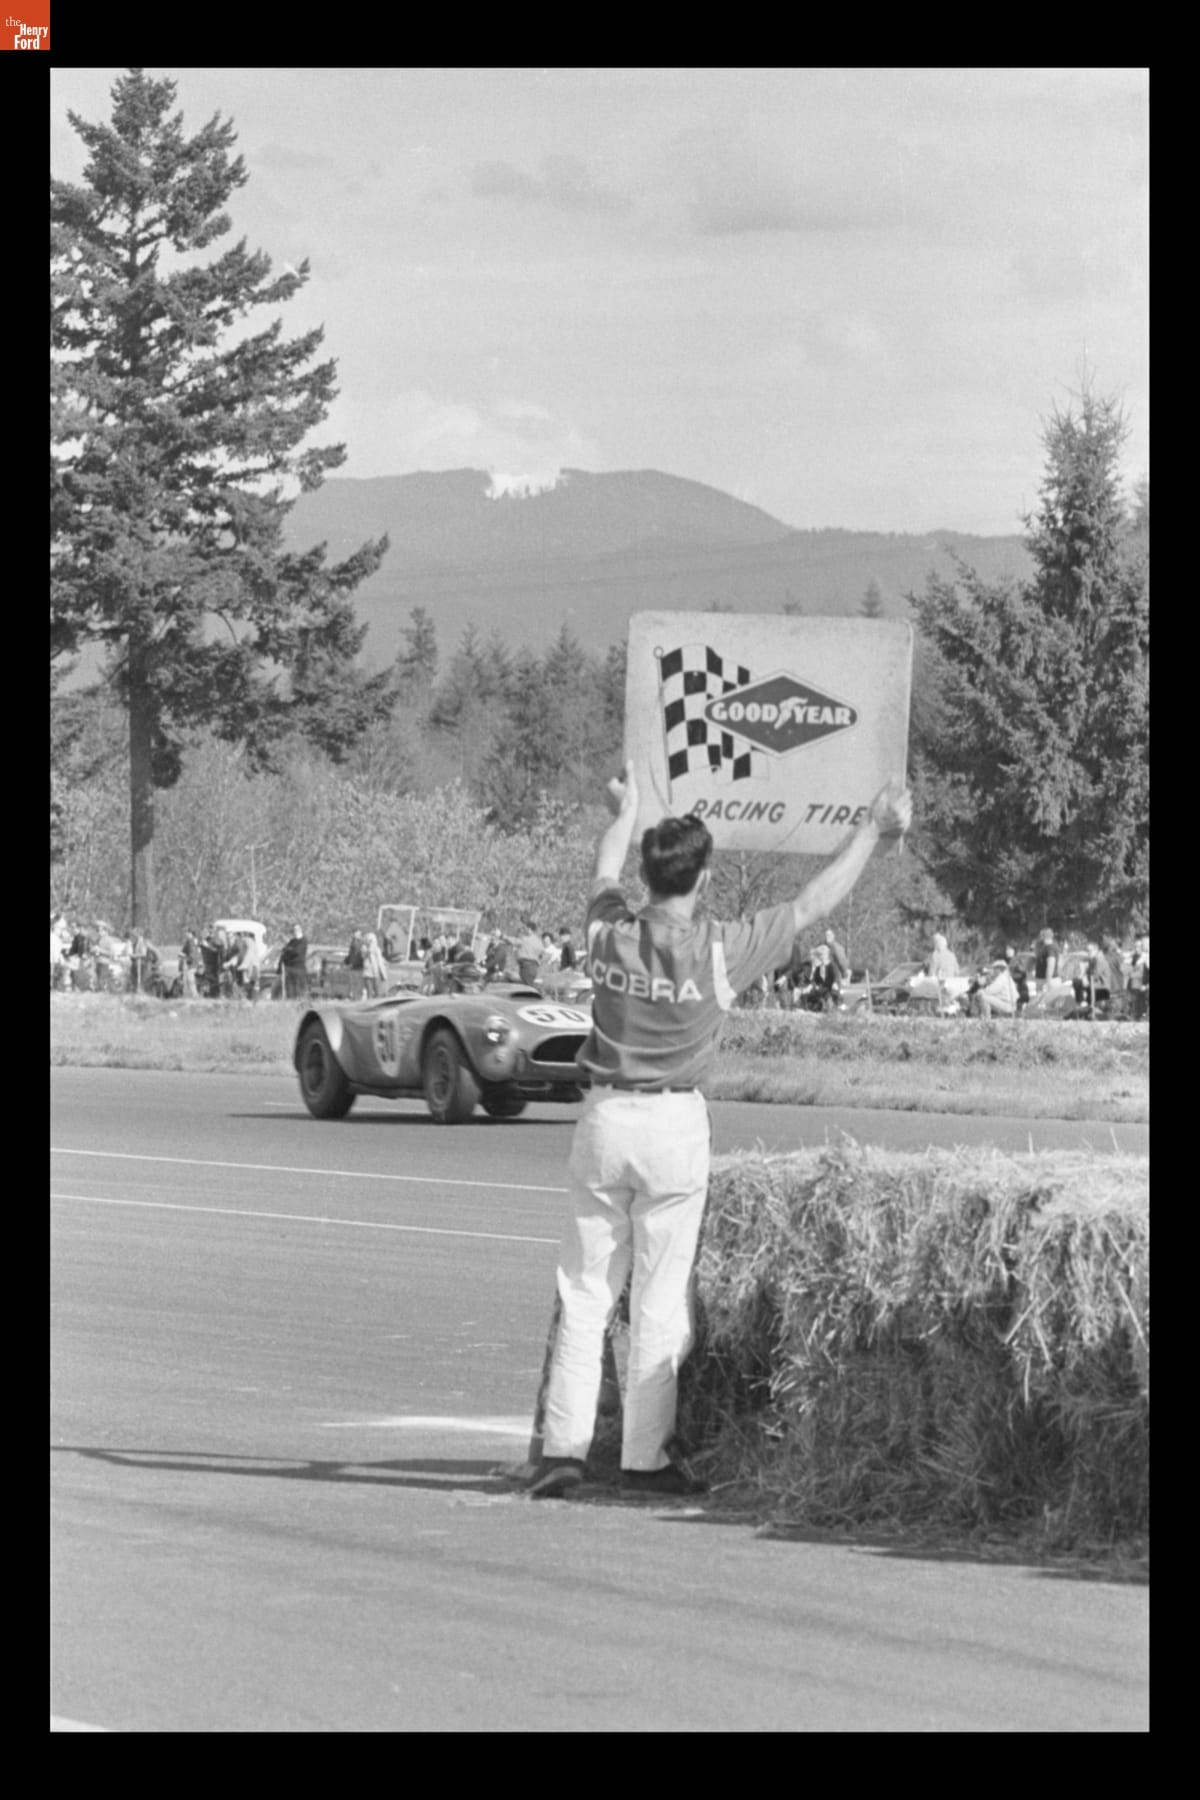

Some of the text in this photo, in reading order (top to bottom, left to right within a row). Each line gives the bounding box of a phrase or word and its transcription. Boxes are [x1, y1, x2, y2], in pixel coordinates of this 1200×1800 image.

[711, 700, 851, 726] GOODYEAR
[690, 798, 786, 824] RACING
[592, 958, 703, 1003] COBRA
[526, 1009, 585, 1023] 50
